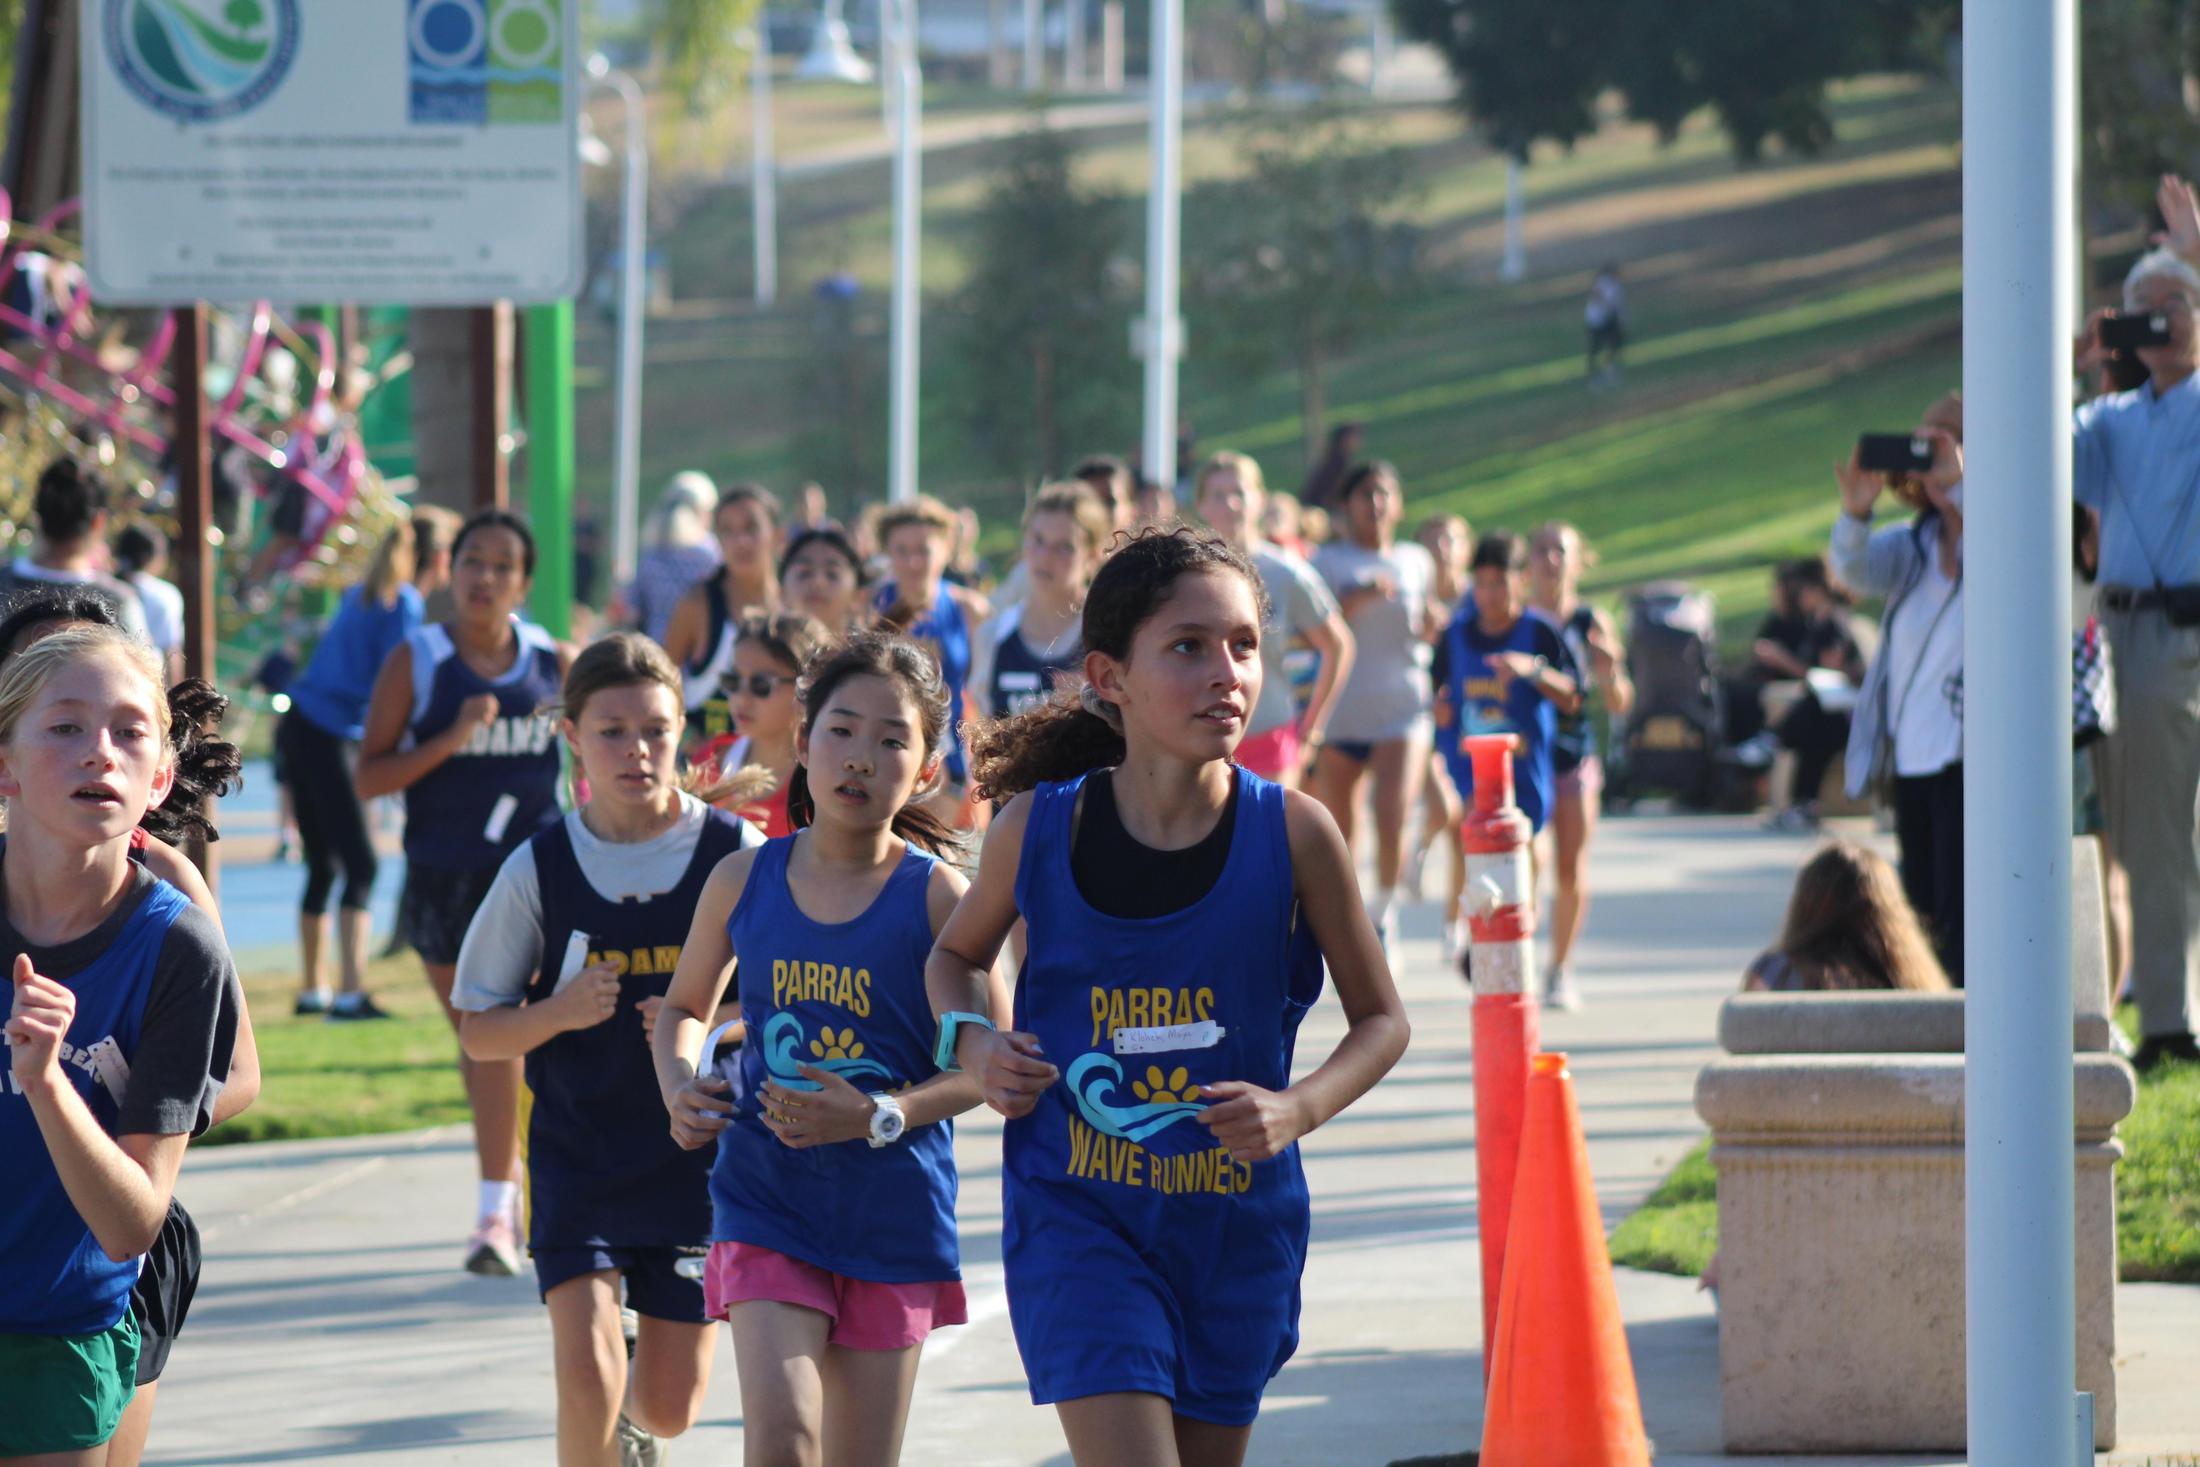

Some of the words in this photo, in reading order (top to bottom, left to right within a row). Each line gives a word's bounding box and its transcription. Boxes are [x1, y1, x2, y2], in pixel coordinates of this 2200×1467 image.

[458, 714, 549, 756] DAMS
[772, 959, 871, 1018] PARRAS
[1090, 986, 1214, 1048] PARRAS
[1066, 1113, 1144, 1187] WAVE
